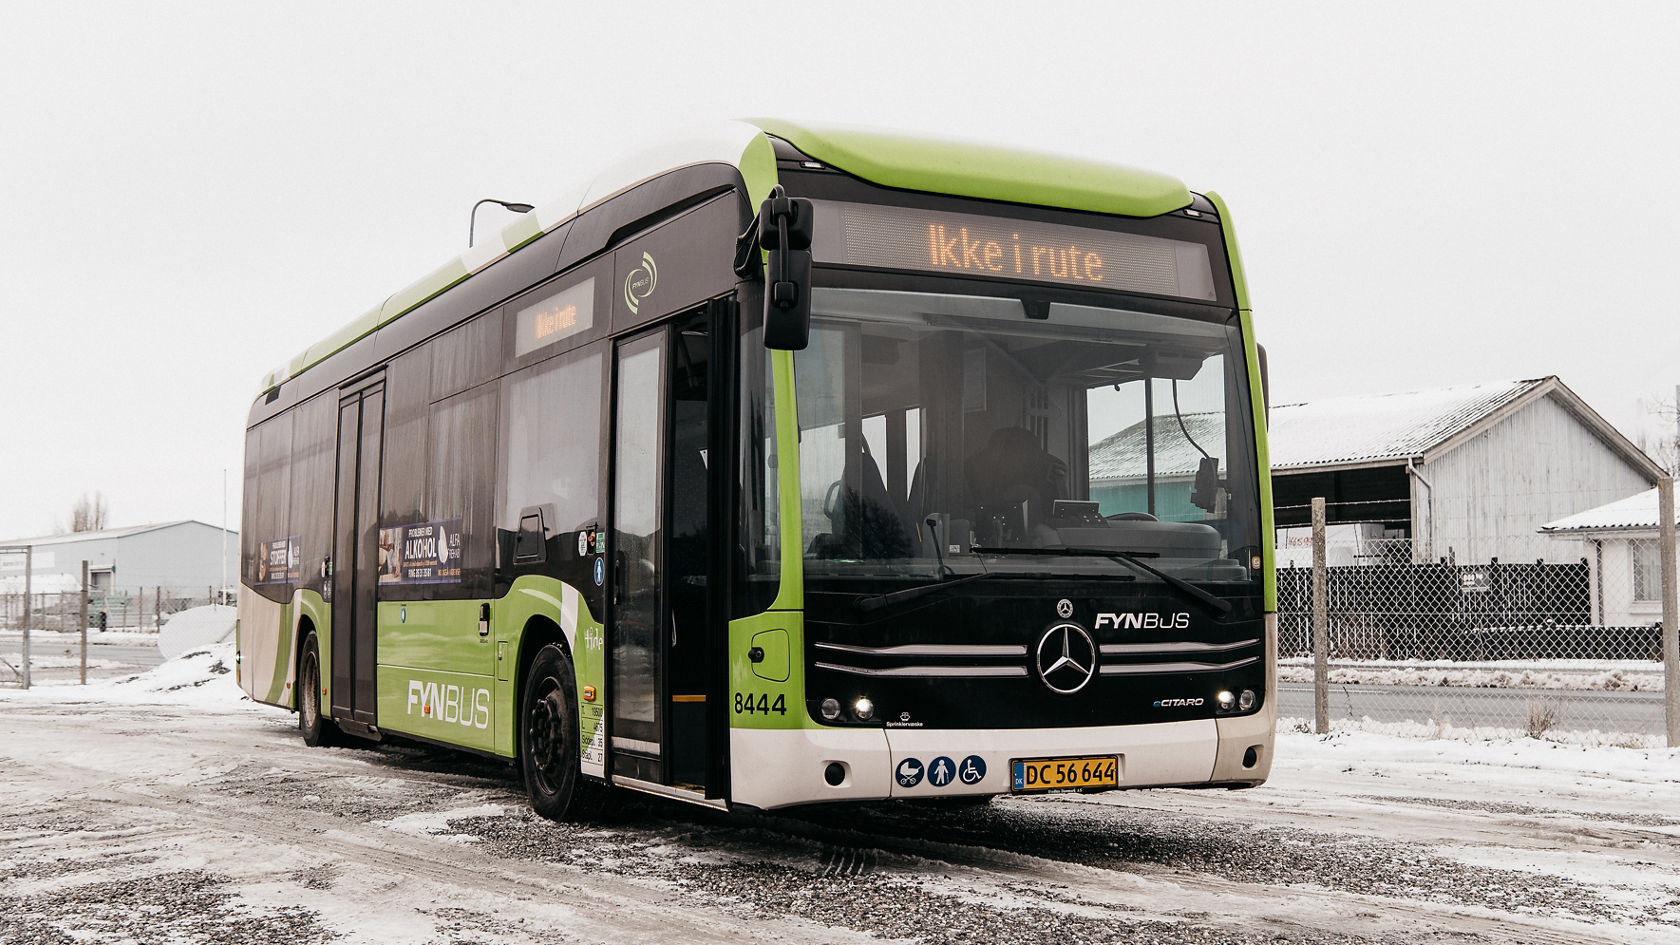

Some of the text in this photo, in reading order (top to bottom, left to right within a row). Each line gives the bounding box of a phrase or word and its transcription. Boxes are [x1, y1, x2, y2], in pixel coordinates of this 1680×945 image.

[929, 224, 1103, 281] Ikke i rute
[404, 537, 437, 560] ALKOHOL
[1094, 612, 1190, 630] FYNBUS
[584, 626, 603, 651] tide
[407, 679, 490, 730] FYNBUS
[734, 692, 787, 716] 8444
[1026, 761, 1115, 785] DC 56 644
